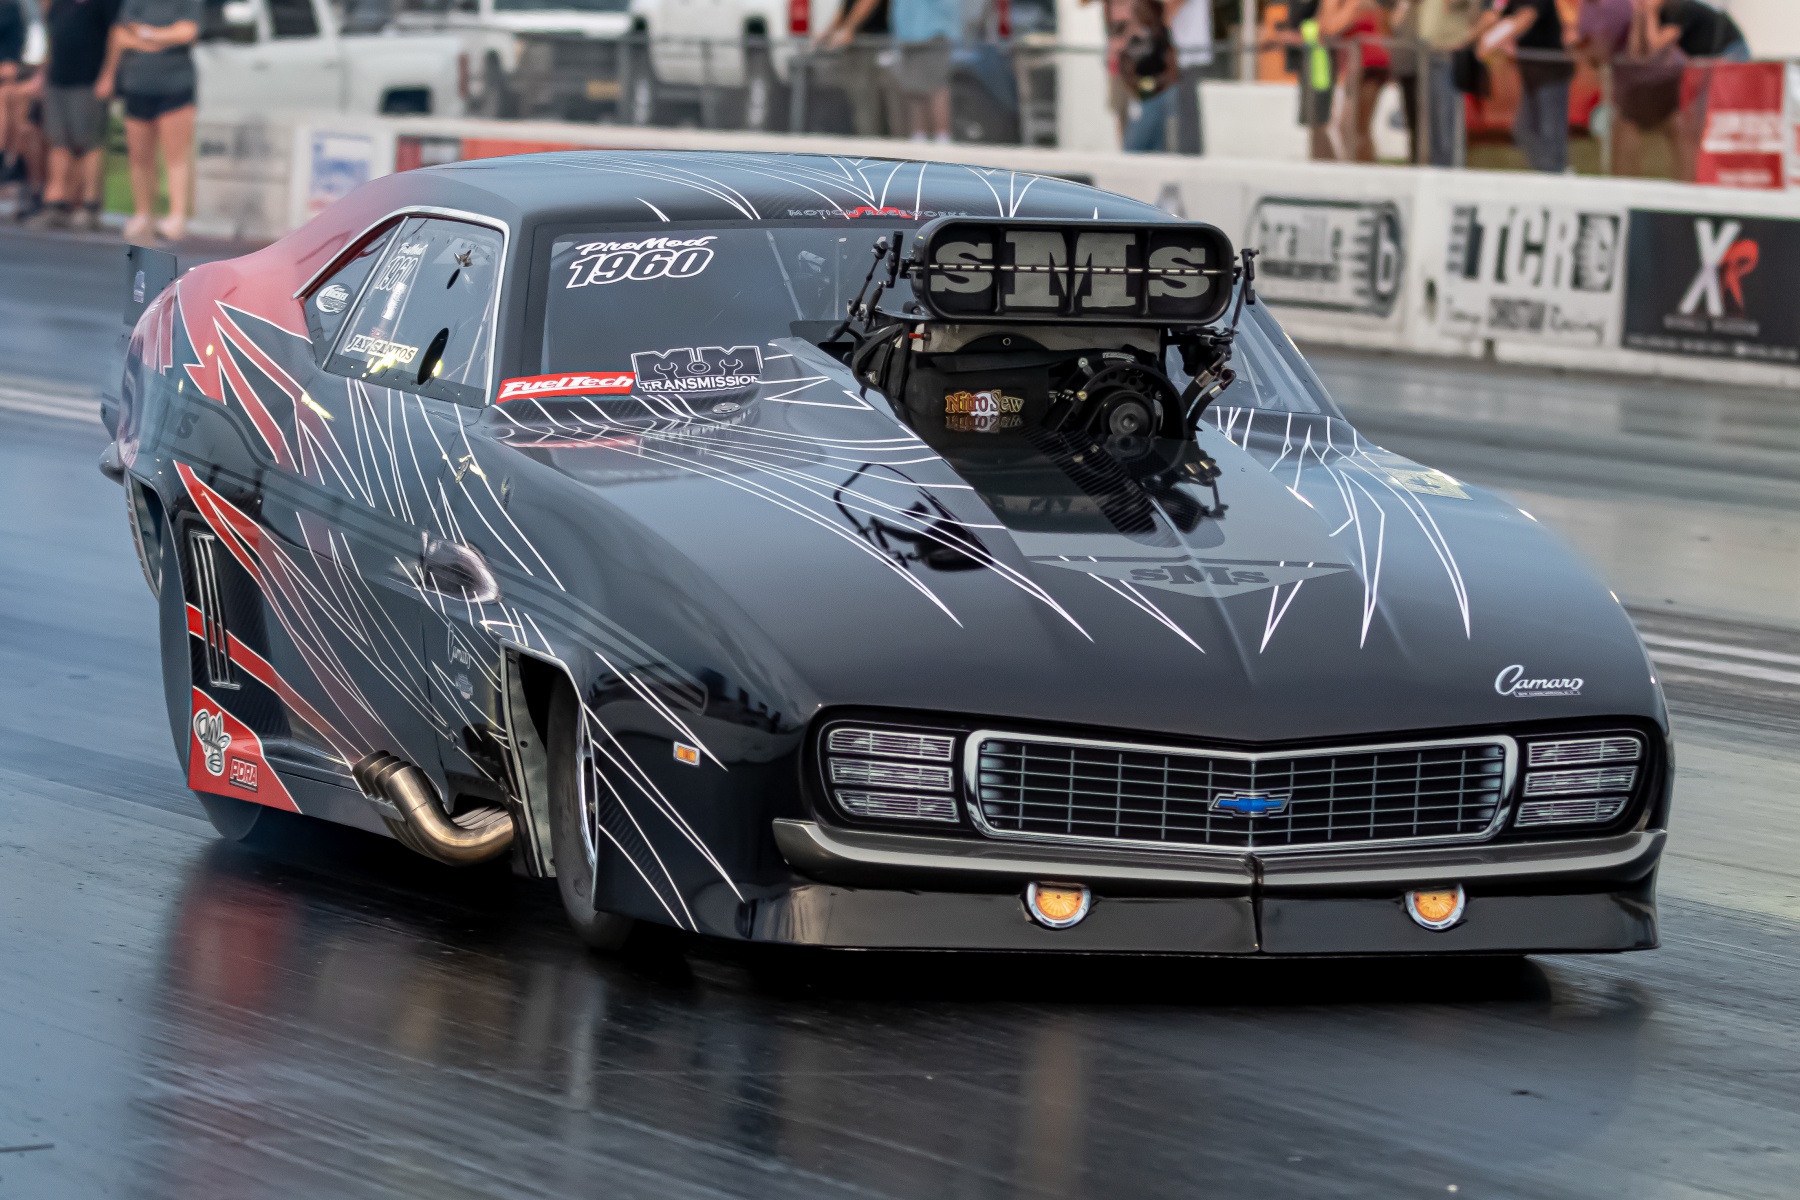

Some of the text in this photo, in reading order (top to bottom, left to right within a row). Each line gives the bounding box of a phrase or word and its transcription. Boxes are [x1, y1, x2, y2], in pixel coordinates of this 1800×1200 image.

[787, 208, 970, 218] MOTION RACEWORKS
[566, 246, 715, 289] 1960
[346, 335, 417, 361] JAY SANTOS
[499, 375, 634, 399] FuelTech
[1494, 664, 1584, 696] Camaro
[230, 759, 258, 786] PDRA
